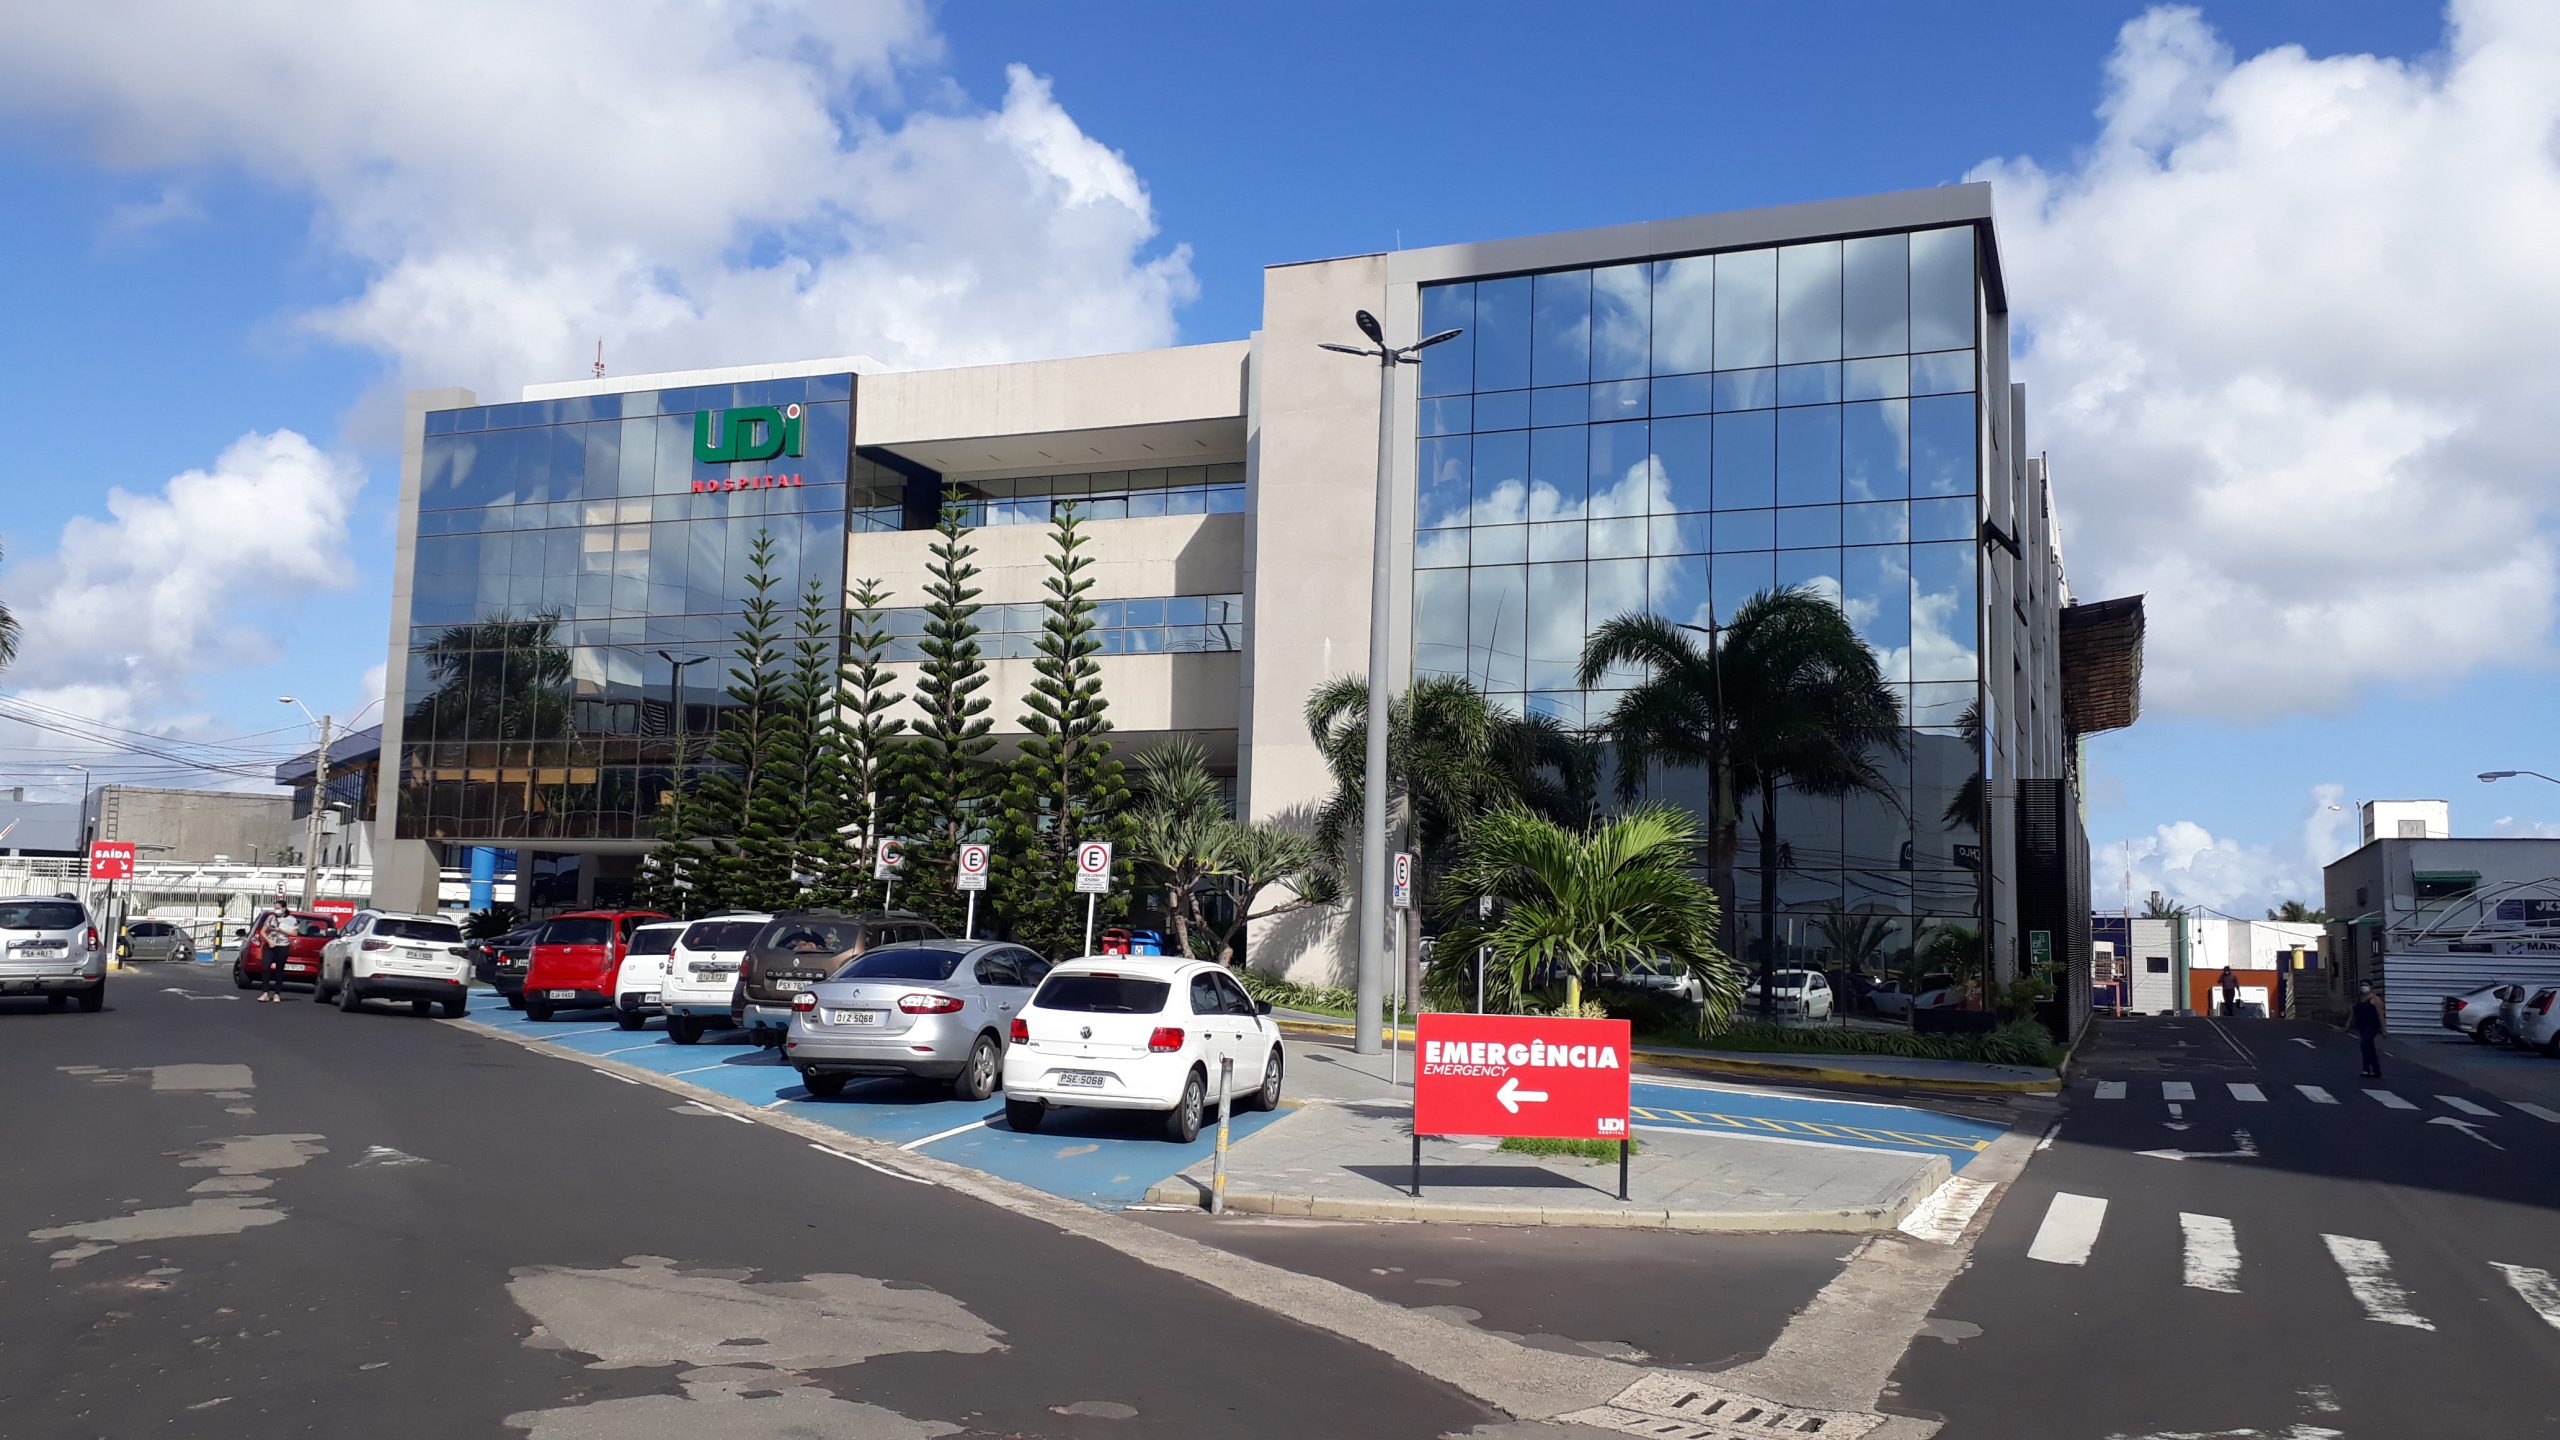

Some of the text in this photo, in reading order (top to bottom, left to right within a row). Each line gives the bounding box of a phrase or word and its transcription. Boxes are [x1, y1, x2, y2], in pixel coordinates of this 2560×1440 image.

[692, 473, 803, 493] HOSPITAL
[95, 848, 131, 859] SAÍDA
[970, 853, 978, 866] E
[1089, 852, 1099, 866] E
[1400, 863, 1404, 879] E
[1425, 1038, 1619, 1069] EMERGÊNCIA
[1423, 1063, 1510, 1077] EMERGENCY
[1598, 1117, 1625, 1131] UDI
